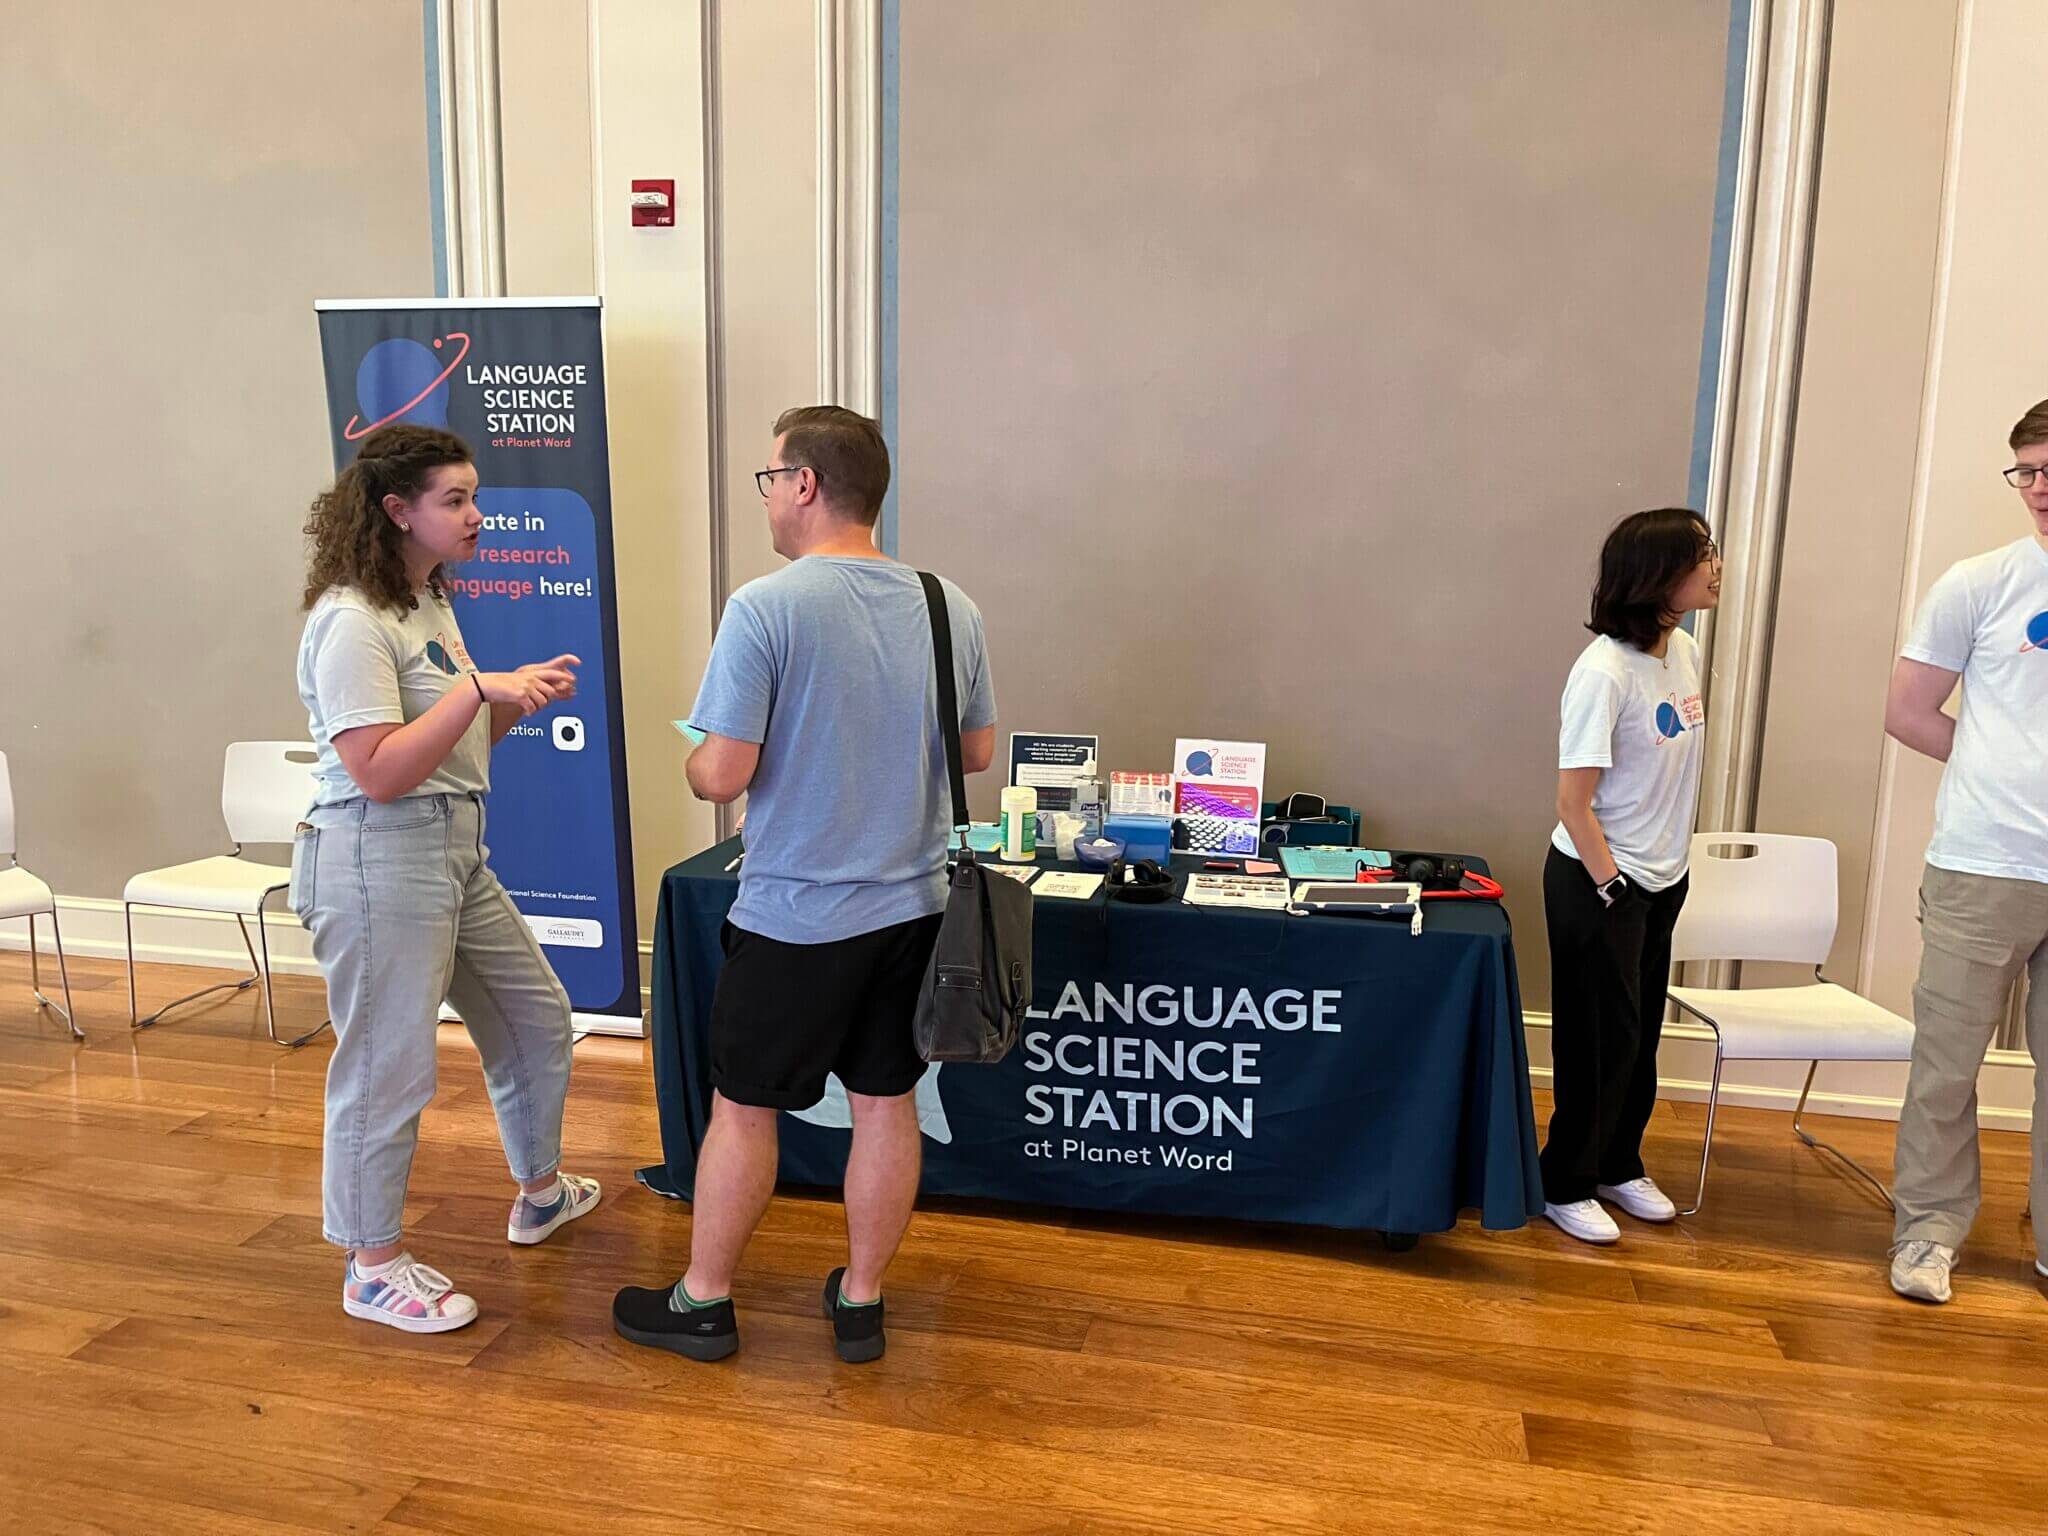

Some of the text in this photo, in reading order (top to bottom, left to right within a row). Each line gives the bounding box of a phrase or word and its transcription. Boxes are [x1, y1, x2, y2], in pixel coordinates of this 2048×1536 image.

[466, 364, 587, 386] LANGUAGE
[483, 388, 575, 409] SCIENCE
[486, 413, 575, 433] STATION
[491, 436, 572, 449] at Planet Word
[478, 511, 545, 531] ate in
[479, 545, 571, 565] research
[453, 576, 592, 600] nguage here!
[507, 724, 544, 737] ation
[1221, 755, 1256, 763] LANGUAGE
[1221, 761, 1247, 769] SCIENCE
[530, 890, 557, 899] Science
[558, 892, 597, 902] Foundation
[1023, 1031, 1262, 1085] SCIENCE
[1024, 1084, 1254, 1139] STATION
[1024, 1138, 1233, 1172] at Planet Word
